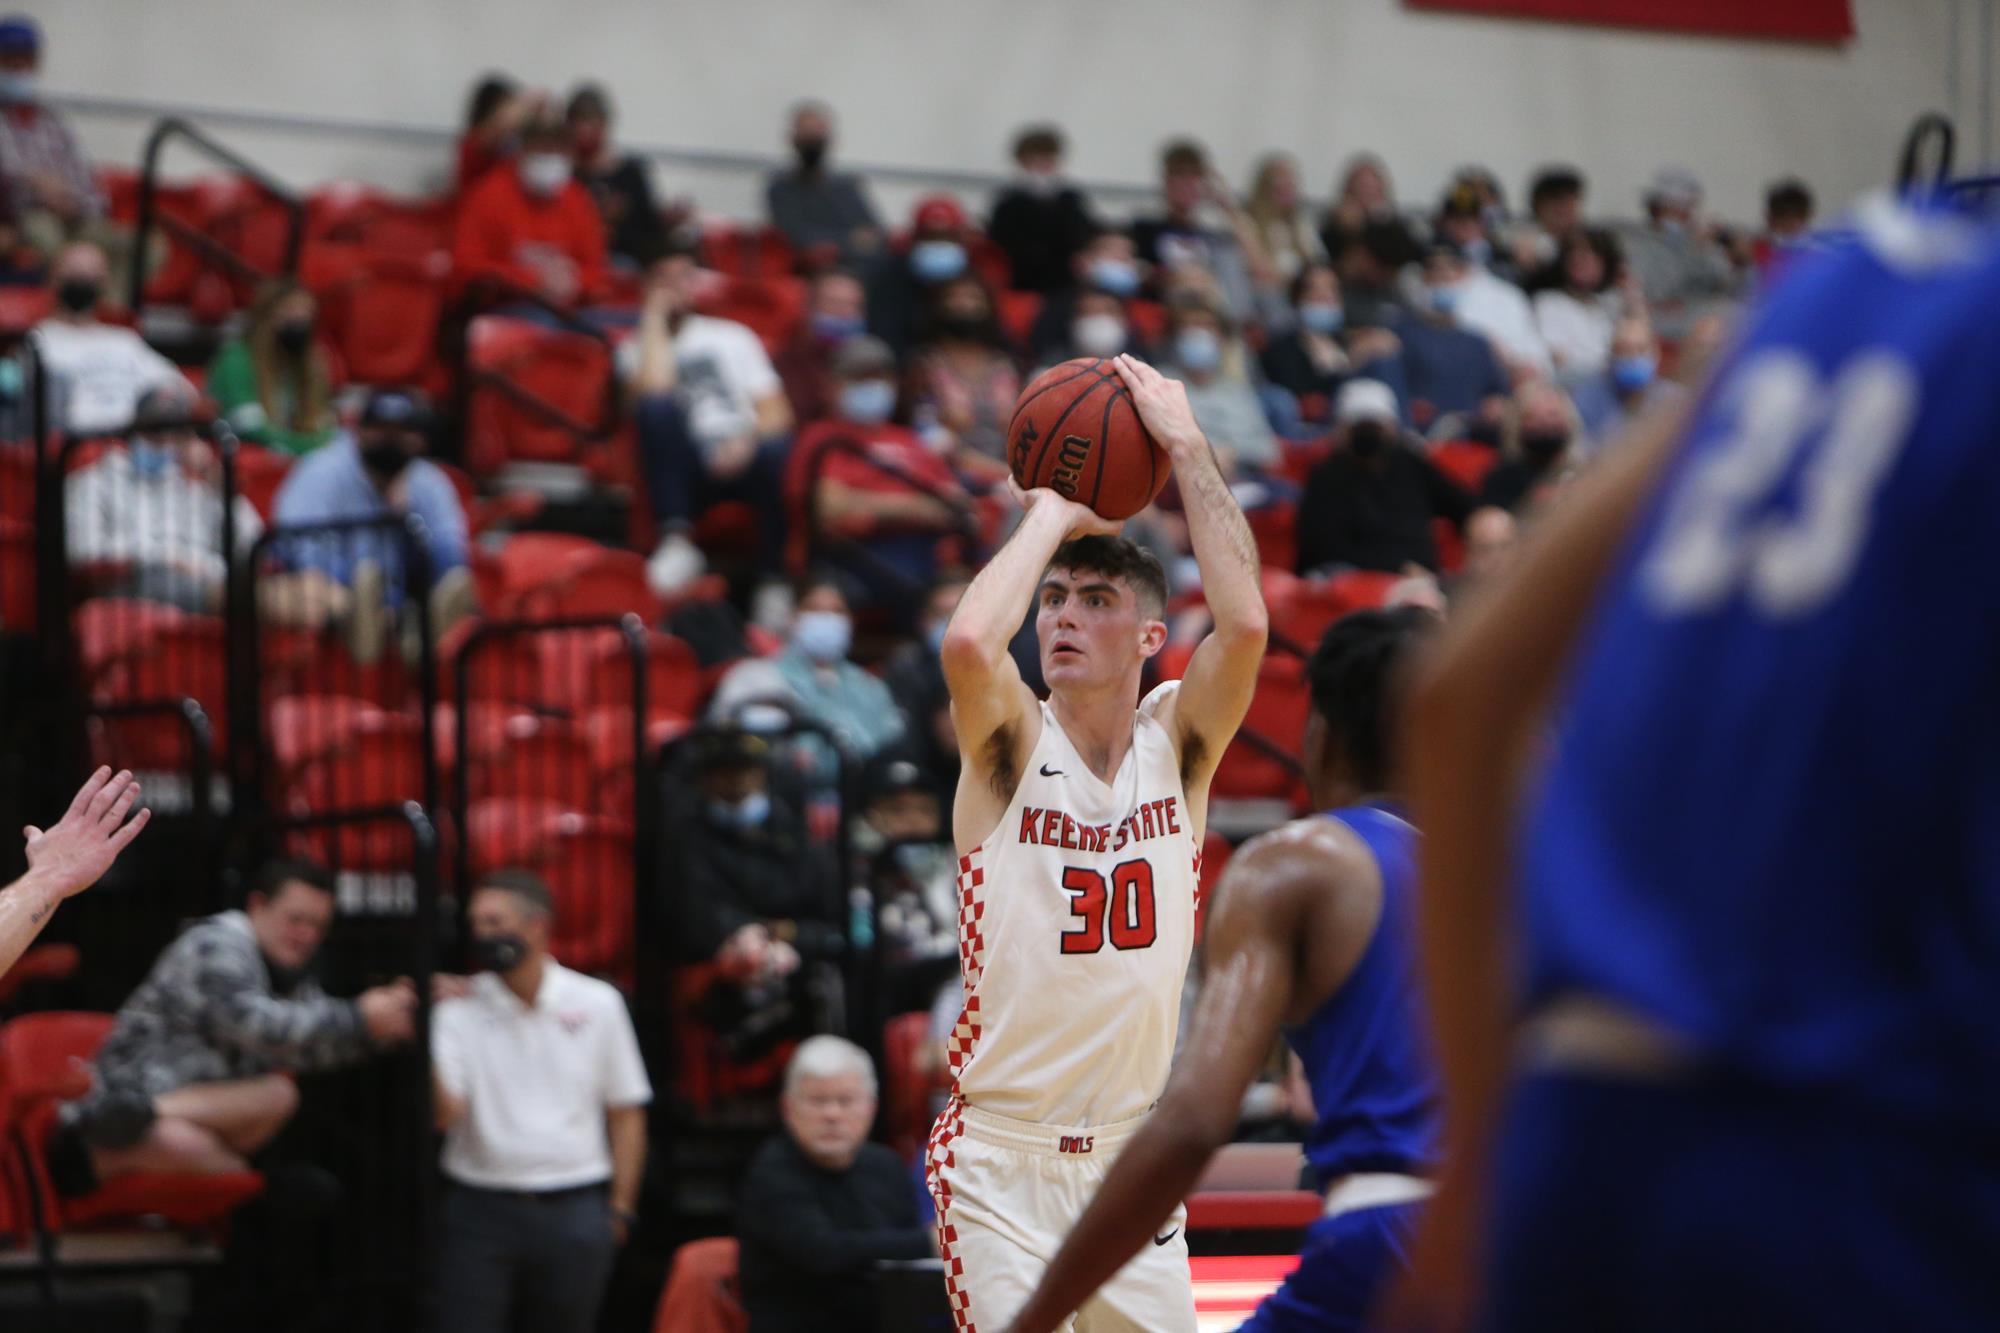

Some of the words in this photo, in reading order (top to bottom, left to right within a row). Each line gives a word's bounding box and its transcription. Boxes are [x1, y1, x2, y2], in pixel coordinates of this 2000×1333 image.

[1019, 806, 1112, 853] KEENE
[1113, 796, 1181, 852] STATE
[1060, 857, 1157, 955] 30
[1059, 1135, 1094, 1154] OWLS
